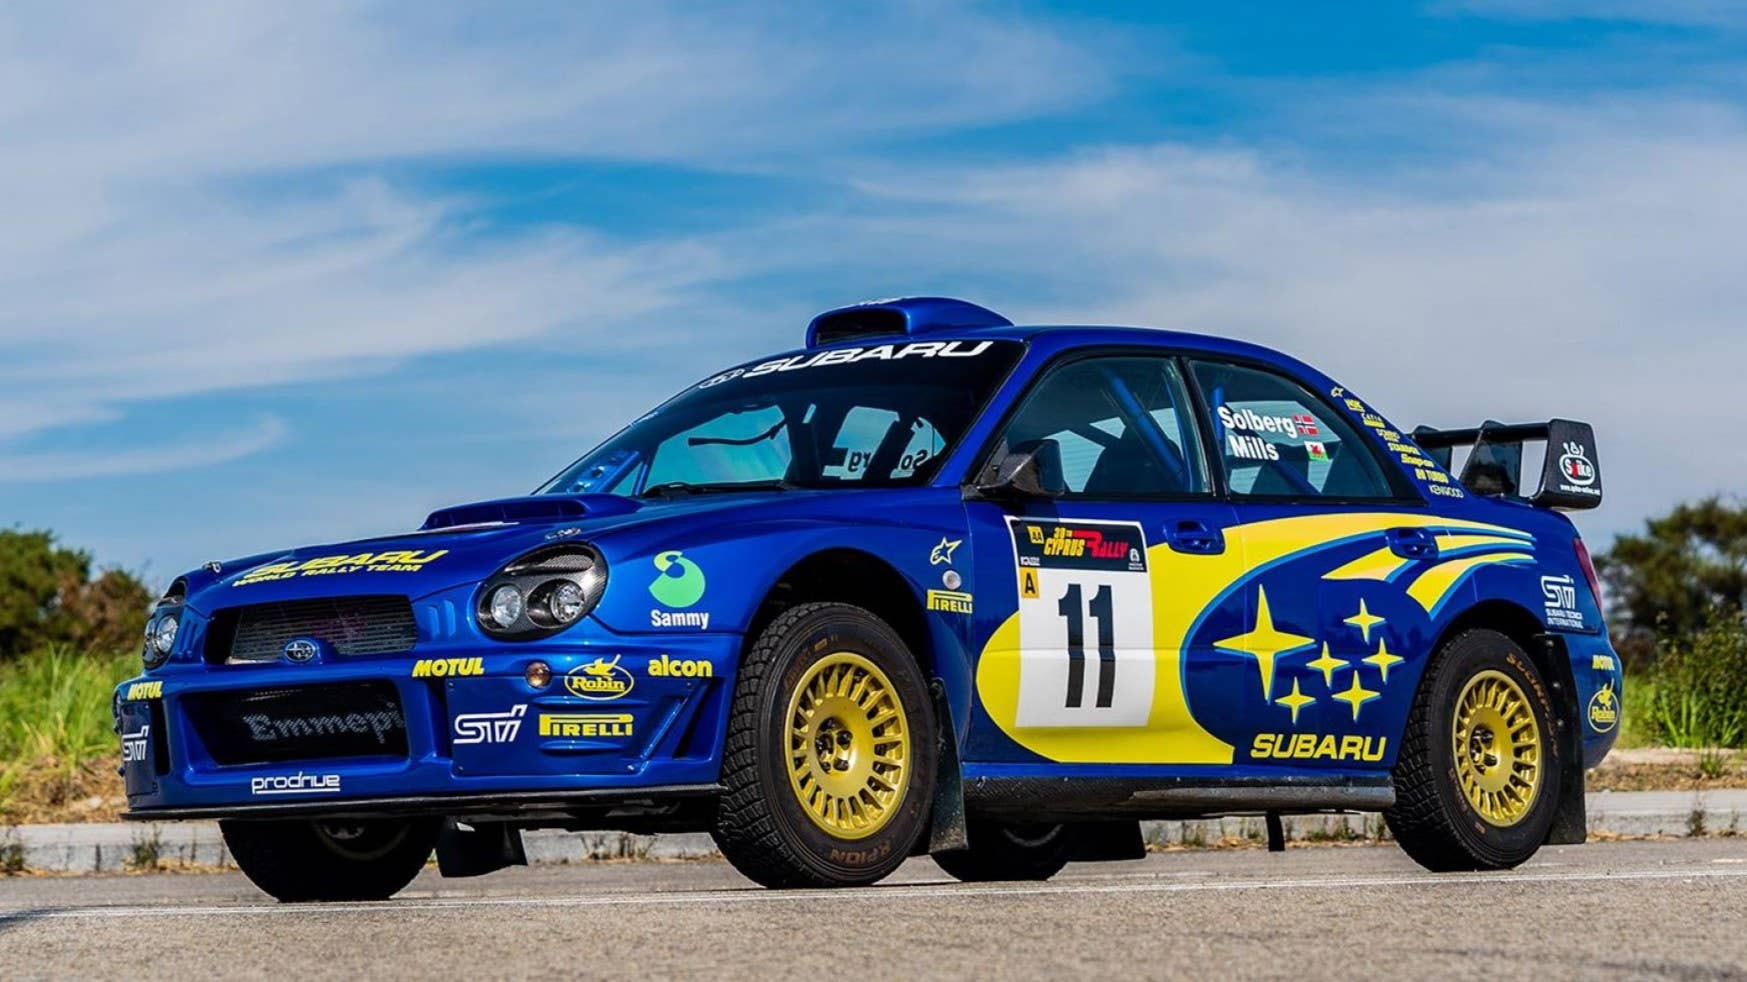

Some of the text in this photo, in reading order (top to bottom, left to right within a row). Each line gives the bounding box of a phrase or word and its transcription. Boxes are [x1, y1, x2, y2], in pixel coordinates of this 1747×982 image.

[742, 340, 993, 378] SUBARU
[1217, 406, 1298, 439] Solberg
[1228, 435, 1280, 461] Mills
[1043, 529, 1128, 559] CYPRUS RALLY
[244, 550, 449, 579] SUBARU
[301, 564, 362, 577] RALLY
[366, 563, 424, 572] TEAM
[1024, 572, 1036, 595] A
[927, 589, 973, 614] PIRELLI
[650, 608, 709, 631] Sammy
[1058, 583, 1115, 708] 11
[411, 656, 485, 678] MOTUL
[647, 654, 713, 677] alcon
[127, 680, 163, 701] MOTUL
[571, 676, 626, 692] Robin
[539, 713, 634, 736] PIRELLI
[1250, 733, 1388, 761] SUBARU
[251, 771, 341, 795] prodrive
